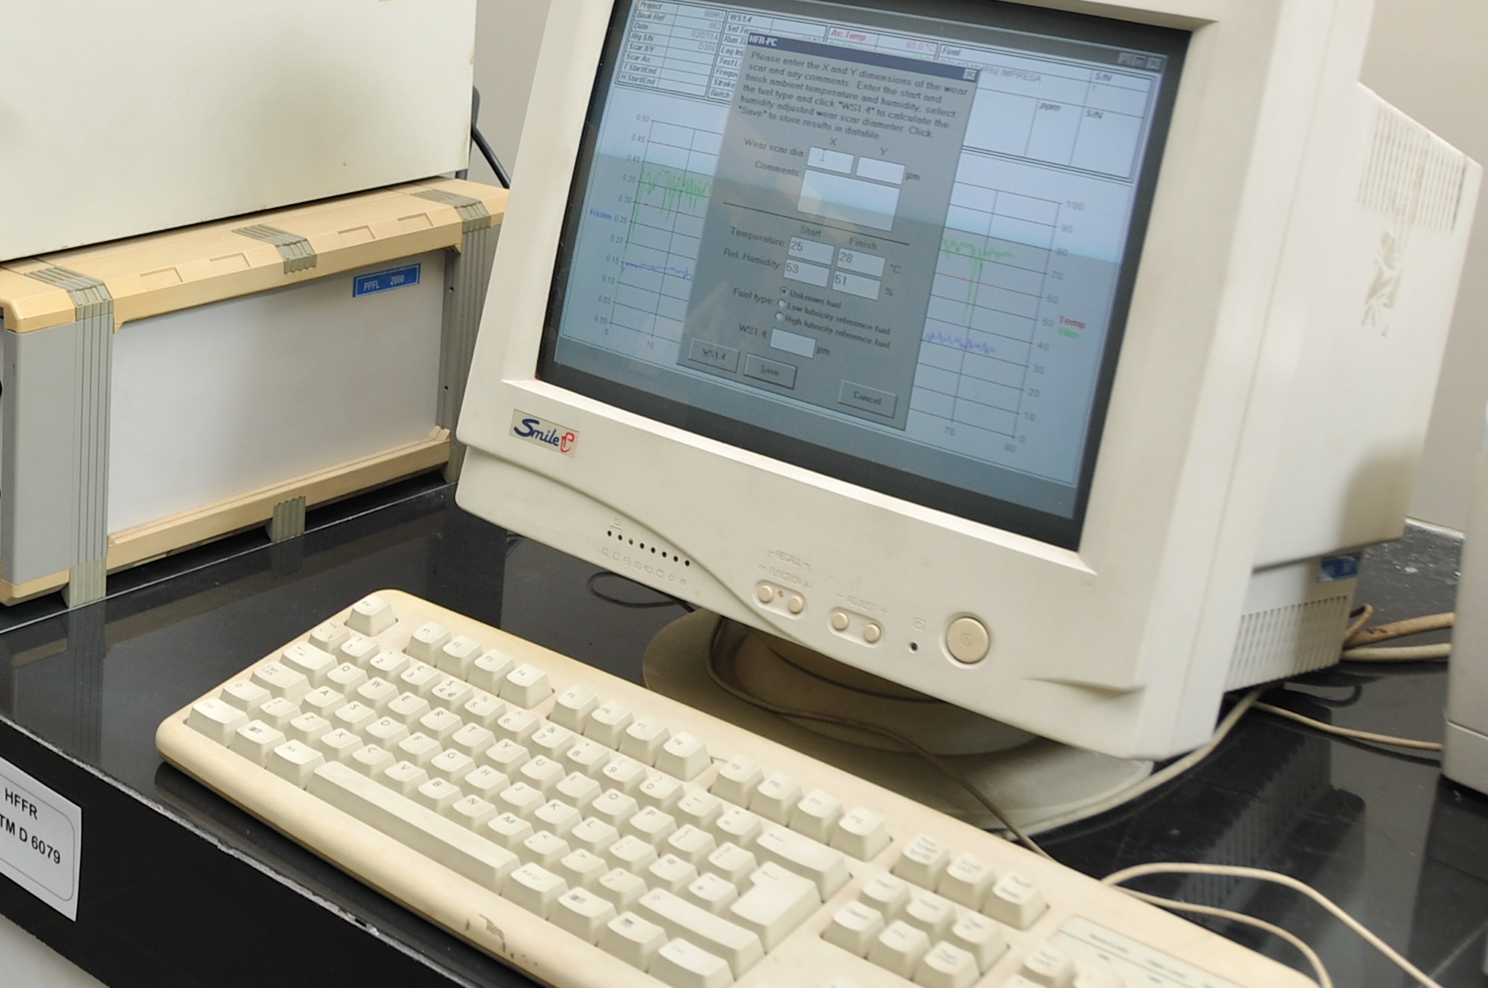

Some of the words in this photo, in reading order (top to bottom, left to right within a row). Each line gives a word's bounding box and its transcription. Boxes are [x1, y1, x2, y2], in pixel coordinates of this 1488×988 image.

[638, 1, 662, 10] Project
[845, 31, 866, 42] Temp
[941, 46, 961, 56] Fuel
[750, 51, 781, 63] Please
[782, 57, 805, 67] enter
[806, 60, 821, 70] the
[821, 63, 829, 71] X
[830, 65, 848, 74] and
[858, 69, 912, 86] dimensions
[914, 79, 924, 88] of
[926, 81, 941, 91] the
[943, 85, 968, 95] wear
[747, 64, 767, 72] scar
[768, 66, 785, 75] and
[786, 71, 802, 80] any
[856, 81, 881, 92] Enter
[882, 86, 897, 95] the
[899, 89, 921, 99] start
[922, 93, 943, 103] and
[744, 73, 767, 84] finish
[769, 77, 804, 90] ambient
[804, 84, 859, 101] temperature
[861, 94, 878, 104] and
[925, 106, 956, 117] select
[742, 84, 756, 93] the
[756, 86, 773, 96] fuel
[774, 90, 794, 101] type
[795, 94, 812, 103] and
[814, 97, 836, 107] click
[876, 108, 886, 117] to
[887, 110, 932, 125] calculate
[933, 119, 950, 129] the
[1038, 101, 1061, 112] ppm
[635, 114, 649, 122] 0.50
[739, 94, 775, 109] humidity
[776, 101, 814, 116] adjusted
[815, 110, 837, 119] wear
[839, 114, 860, 124] scar
[907, 125, 932, 137] Click
[768, 111, 777, 119] to
[778, 114, 801, 124] store
[802, 117, 832, 130] results
[833, 124, 843, 132] in
[631, 134, 645, 142] 0.45
[829, 137, 837, 146] X
[743, 137, 767, 149] Wear
[769, 144, 788, 154] scar
[879, 147, 888, 156] Y
[1065, 200, 1084, 211] 100
[589, 208, 612, 220] Friction
[613, 214, 627, 224] 0.25
[799, 224, 821, 238] Start
[609, 234, 623, 244] 0.20
[790, 239, 804, 251] 25
[848, 235, 878, 250] Finish
[605, 254, 619, 264] 0.15
[838, 251, 853, 263] 28
[785, 261, 799, 273] 53
[363, 279, 380, 291] PPFL
[390, 274, 405, 285] 2000
[601, 275, 615, 284] 0.10
[834, 274, 847, 285] 51
[732, 286, 752, 299] Fuel
[597, 295, 611, 304] 0.05
[789, 289, 825, 305] Unknown
[825, 298, 841, 309] fuel
[593, 314, 607, 325] 0.00
[786, 302, 803, 312] Low
[803, 307, 834, 321] lubricity
[835, 315, 873, 331] reference
[874, 324, 891, 335] fuel
[1058, 315, 1086, 330] Temp
[783, 314, 802, 327] High
[803, 320, 834, 335] lubricity
[834, 328, 873, 345] reference
[873, 338, 891, 349] fuel
[645, 341, 654, 349] 10
[1036, 341, 1048, 351] 40
[759, 364, 780, 377] Save
[1032, 364, 1044, 374] 30
[852, 390, 882, 405] Cancel
[1027, 387, 1039, 398] 20
[1023, 411, 1035, 422] 10
[514, 418, 559, 447] Smile
[943, 425, 956, 436] 70
[4, 788, 38, 820] HFFR
[19, 827, 28, 843] D
[31, 835, 61, 864] 6079
